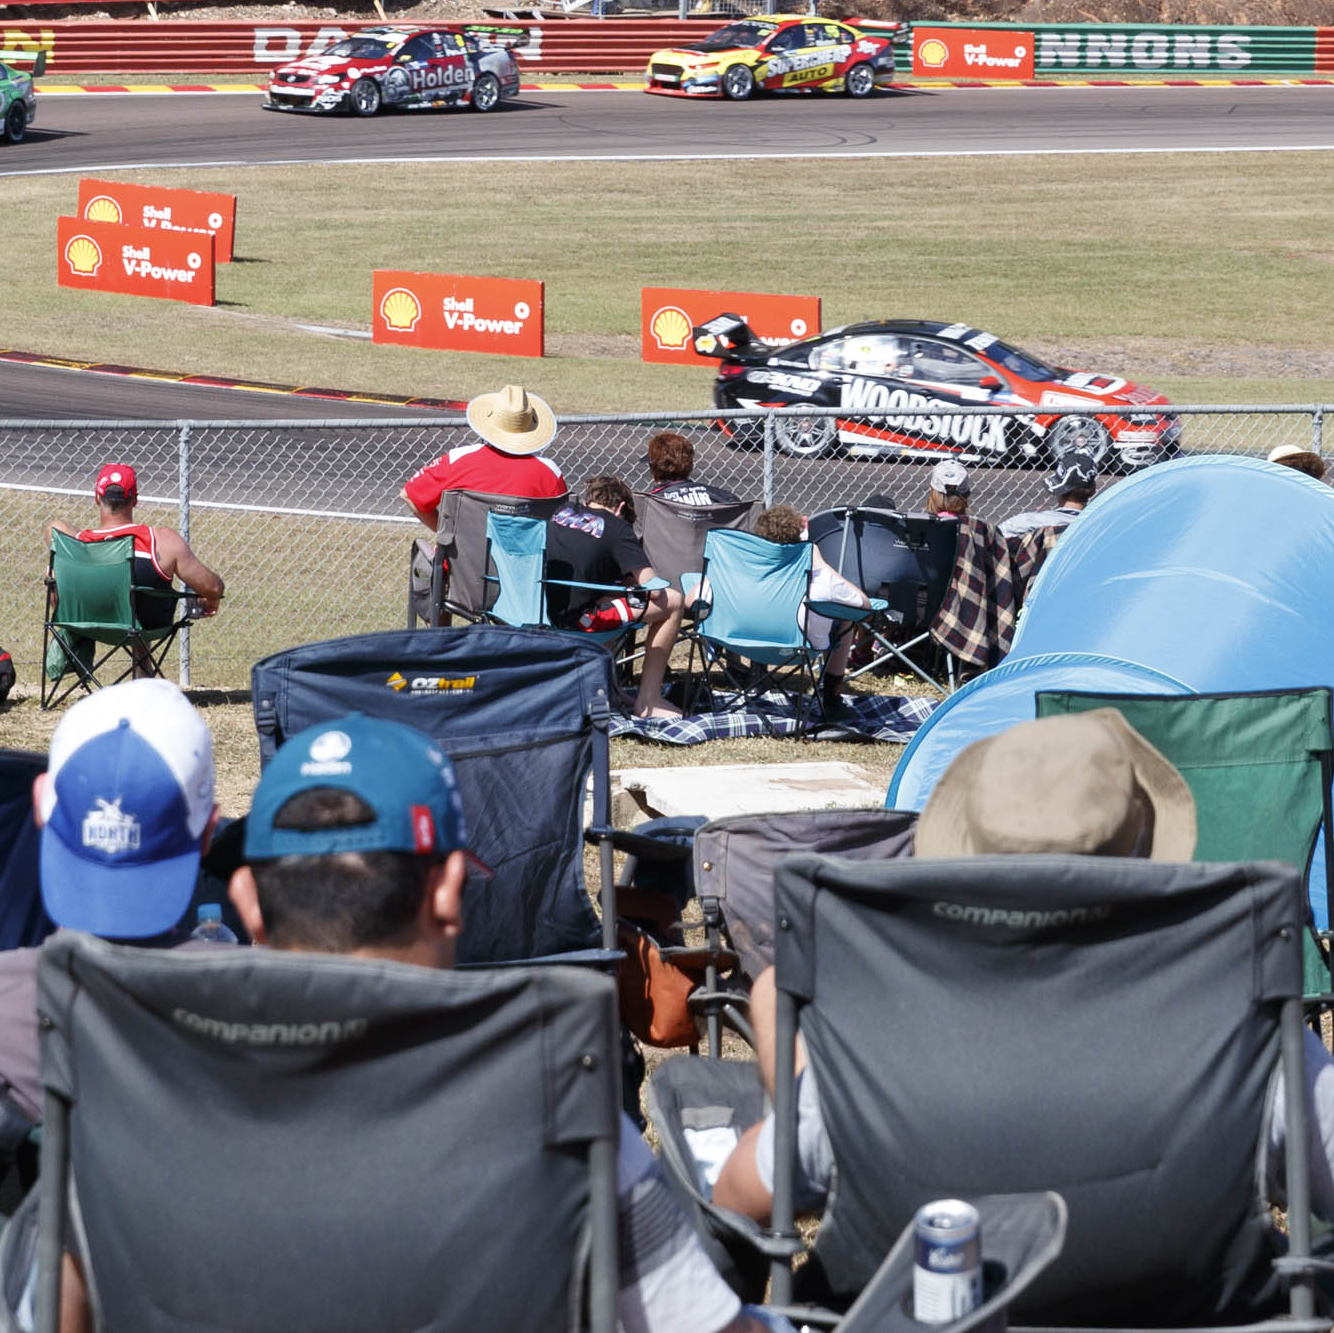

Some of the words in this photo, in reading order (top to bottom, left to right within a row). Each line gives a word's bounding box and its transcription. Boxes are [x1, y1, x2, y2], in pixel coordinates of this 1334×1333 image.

[964, 44, 987, 54] Shell
[964, 53, 1022, 68] V-Power
[413, 64, 475, 89] Holden
[788, 67, 828, 82] AUTO
[142, 206, 172, 220] Shell
[122, 245, 151, 260] Shell
[123, 258, 196, 283] V-Power
[443, 297, 474, 313] Shell
[443, 311, 523, 335] V-Power
[841, 376, 1011, 452] WOODSTOCK
[932, 901, 1088, 929] companion
[172, 1007, 341, 1045] companion
